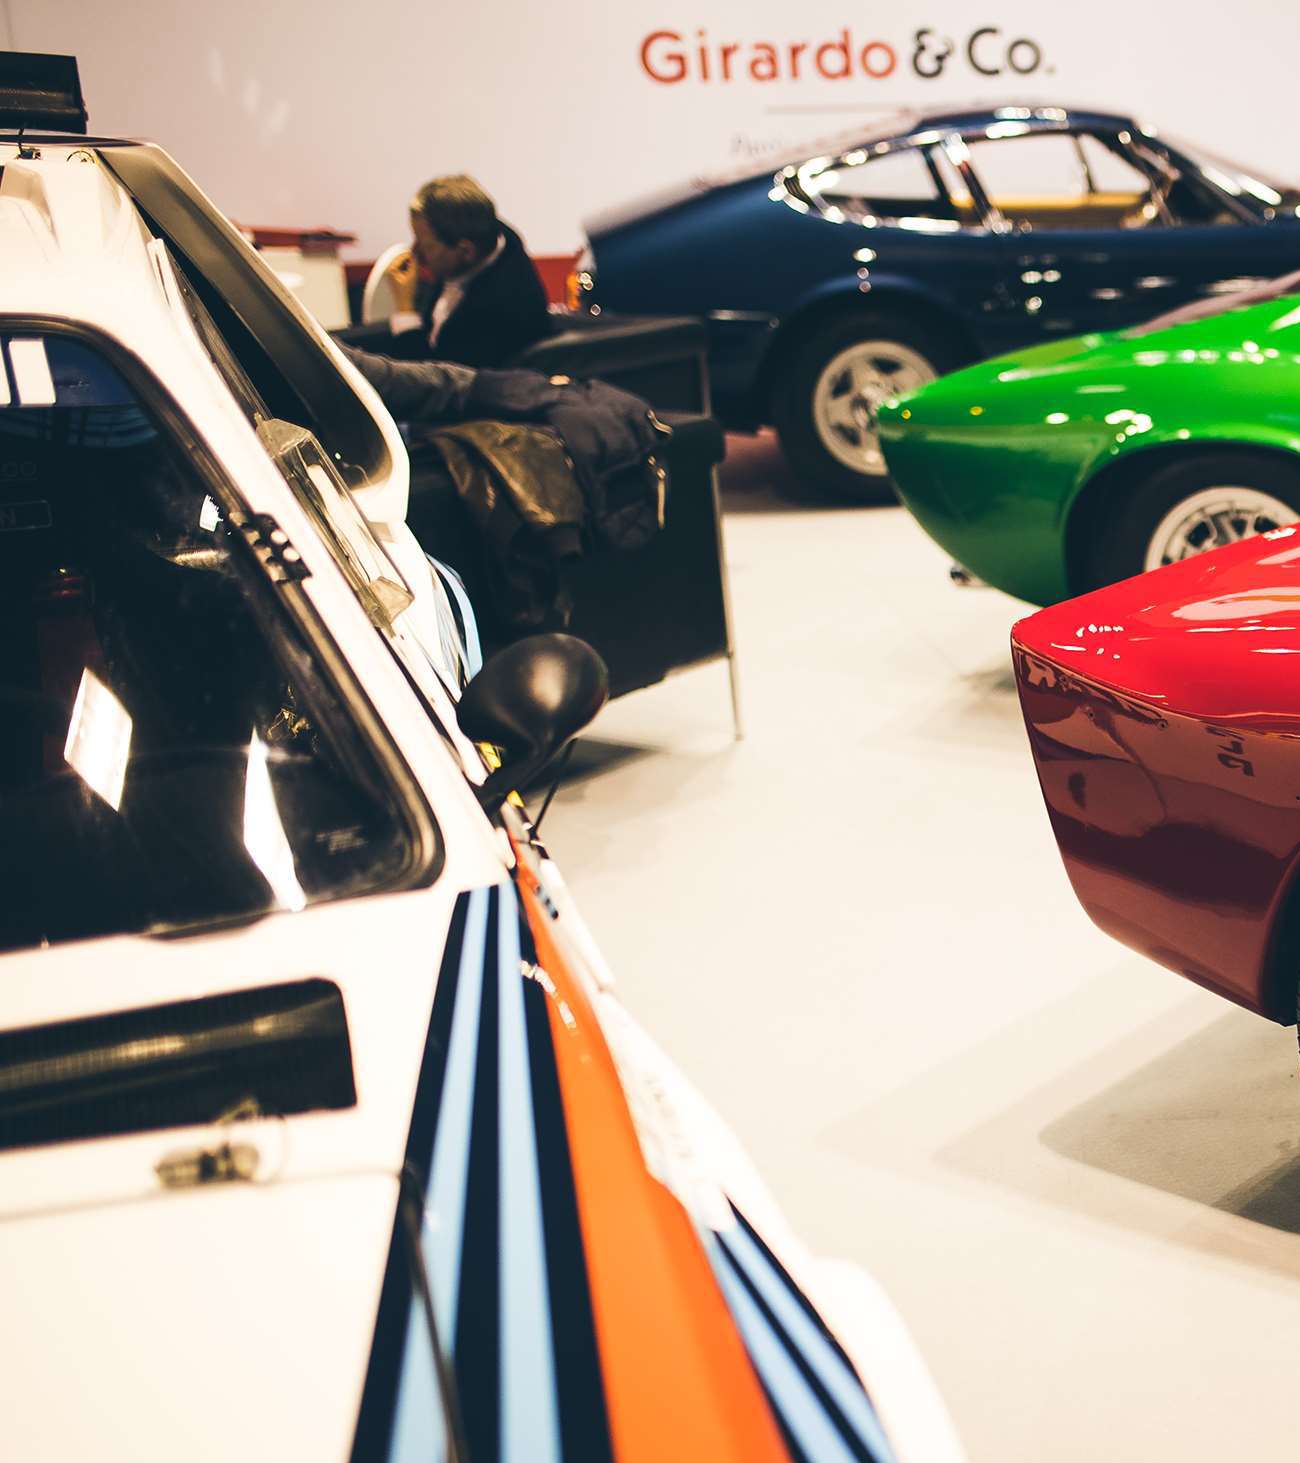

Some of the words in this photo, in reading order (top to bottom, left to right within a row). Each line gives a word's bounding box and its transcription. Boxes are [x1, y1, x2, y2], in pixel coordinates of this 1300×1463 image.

[640, 29, 897, 84] Girardo
[912, 28, 954, 79] &
[967, 27, 1056, 76] Co.
